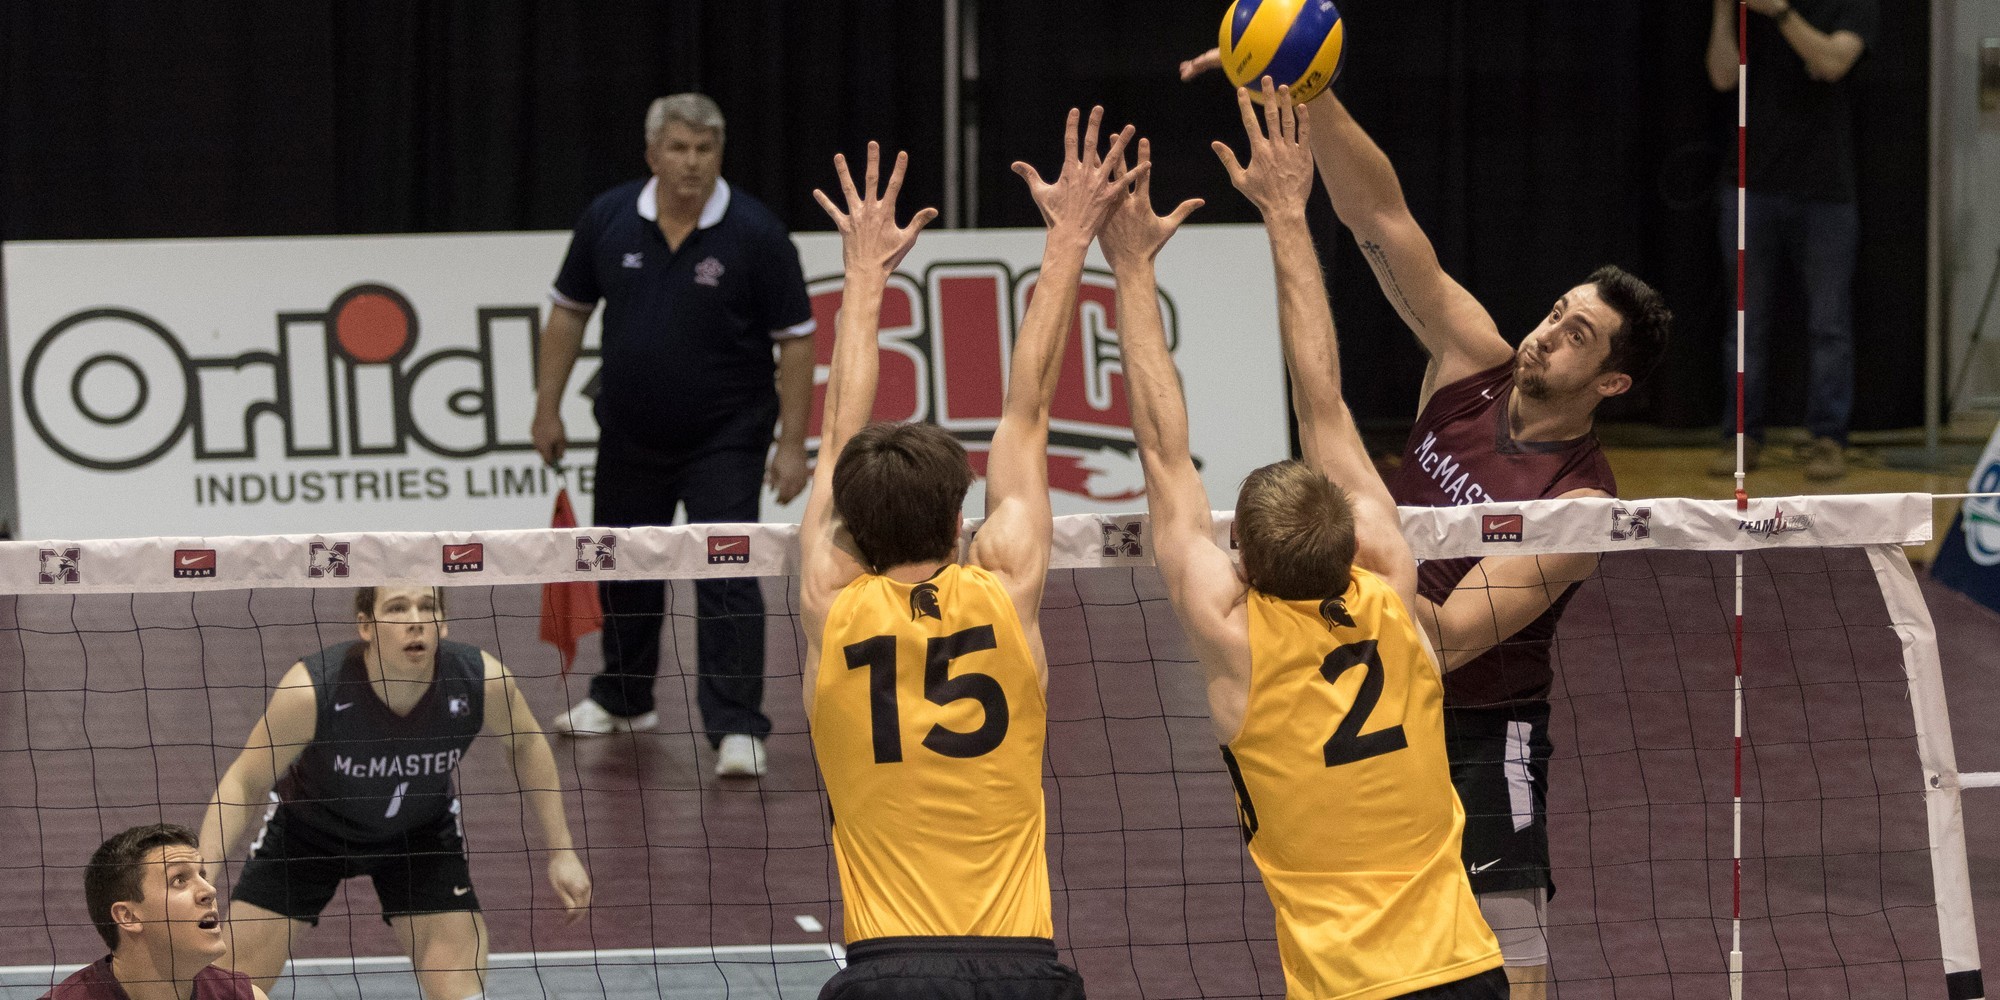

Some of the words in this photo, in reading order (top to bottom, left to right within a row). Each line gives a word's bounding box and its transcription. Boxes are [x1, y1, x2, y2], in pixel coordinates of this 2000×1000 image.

[22, 280, 601, 471] Orlick
[194, 469, 450, 506] INDUSTRIES
[843, 624, 1010, 764] 15
[1319, 639, 1409, 768] 2
[334, 748, 460, 778] McMASTER
